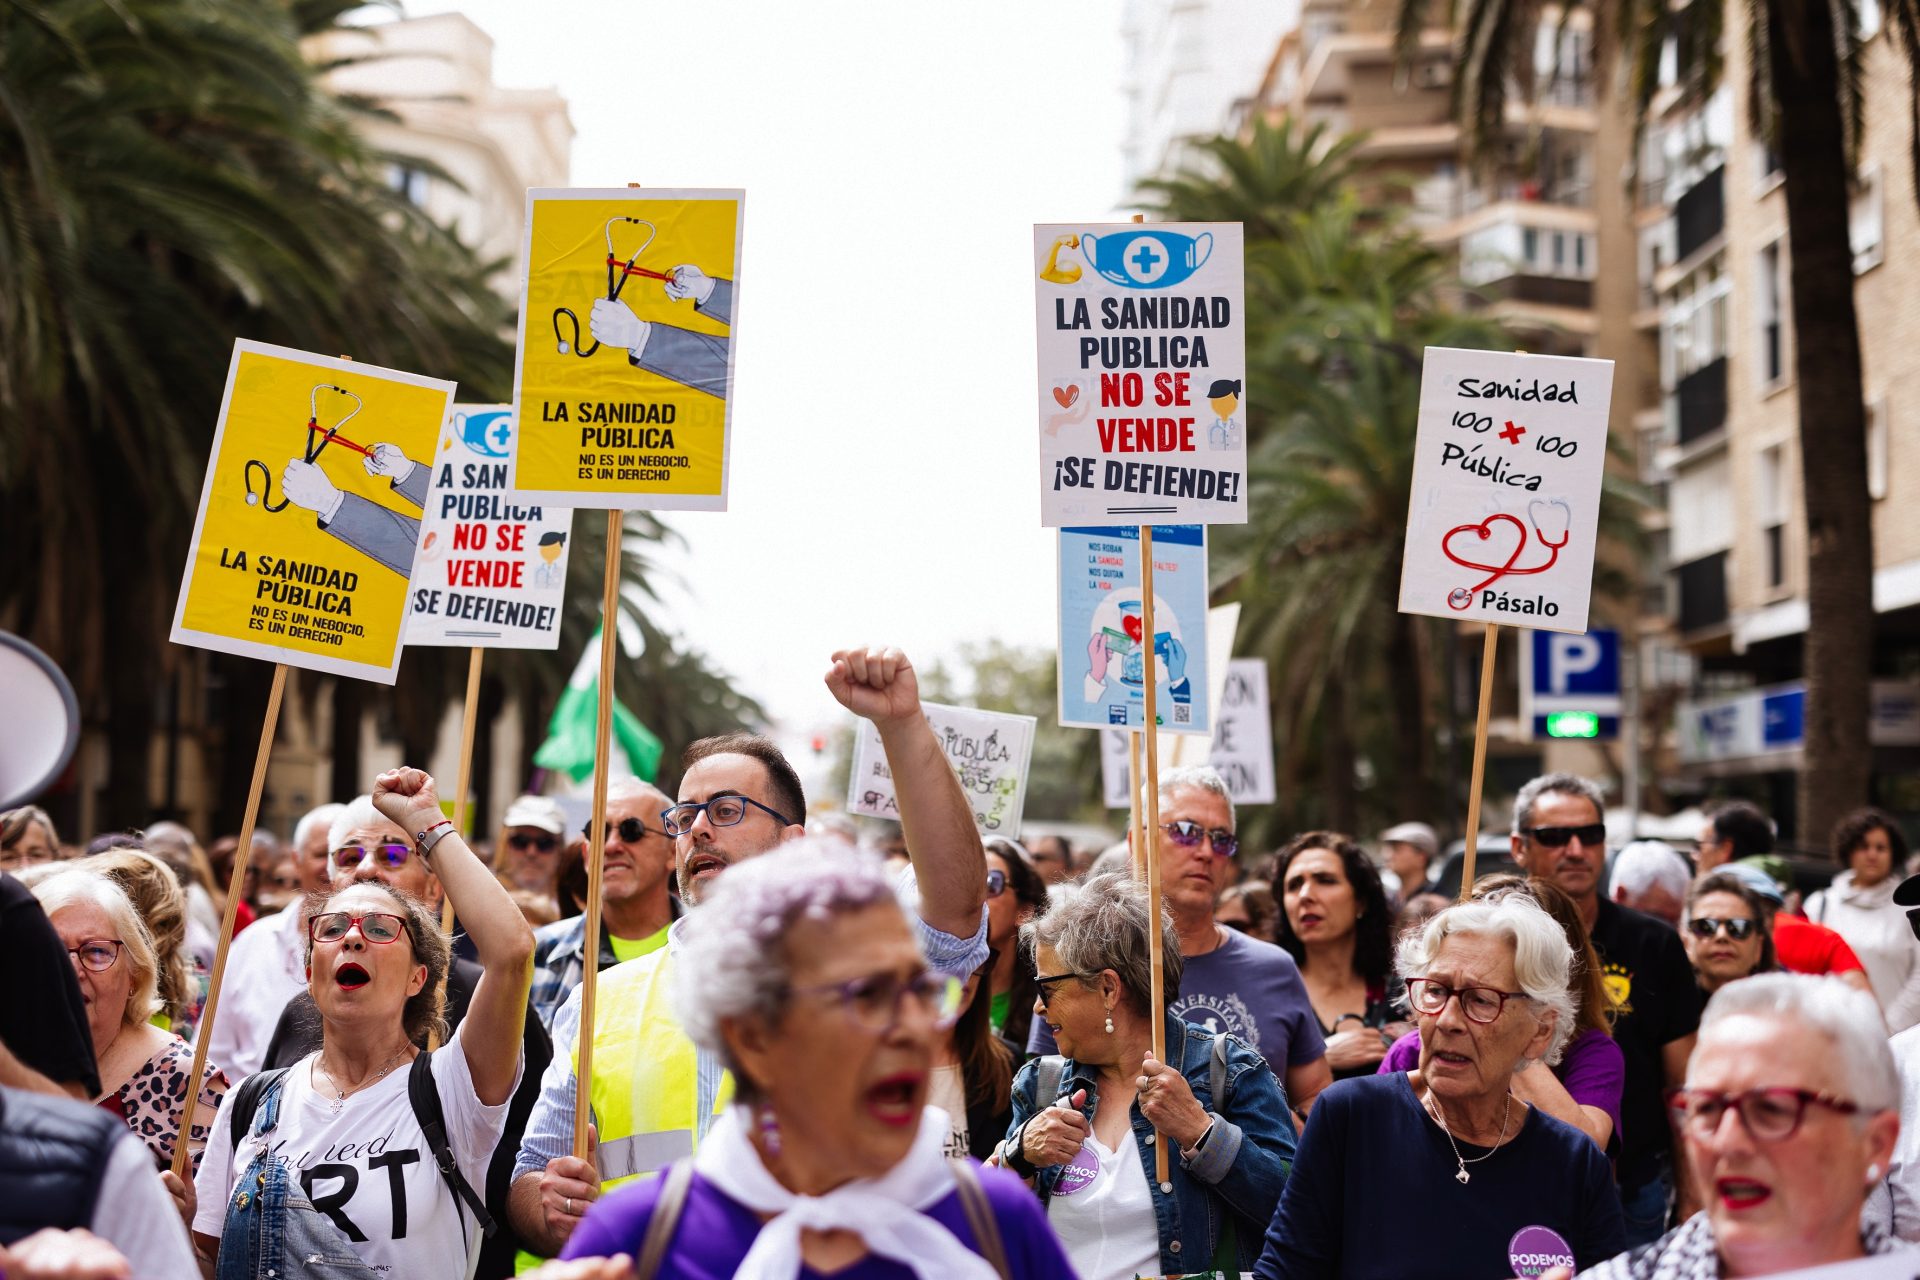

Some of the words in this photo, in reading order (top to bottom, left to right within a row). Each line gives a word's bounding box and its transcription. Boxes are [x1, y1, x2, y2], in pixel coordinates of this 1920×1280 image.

[1056, 298, 1091, 330] LA
[1101, 297, 1230, 329] SANIDAD
[1080, 336, 1208, 369] PUBLICA
[1101, 373, 1143, 407] NO
[1155, 372, 1190, 406] SE
[1458, 379, 1578, 404] Sanidad
[543, 402, 568, 422] LA
[578, 403, 676, 425] SANIDAD
[582, 424, 674, 449] PÚBLICA
[1097, 418, 1195, 452] VENDE
[1452, 411, 1492, 433] 100
[1536, 436, 1577, 458] 100
[437, 463, 453, 488] A
[579, 468, 592, 479] ES
[597, 469, 613, 479] UN
[618, 469, 670, 480] DERECHO
[580, 454, 595, 465] NO
[600, 455, 613, 465] ES
[619, 455, 634, 466] UN
[638, 455, 691, 470] NEGOCIO,
[1441, 442, 1543, 492] Pública
[1054, 457, 1096, 490] ¡SE
[1104, 460, 1240, 502] DEFIENDE!
[454, 524, 487, 550] NO
[496, 525, 525, 551] SE
[1088, 543, 1100, 551] NOS
[1102, 544, 1123, 554] ROBAN
[220, 548, 246, 571] LA
[256, 555, 358, 592] SANIDAD
[448, 560, 524, 588] VENDE
[1088, 556, 1096, 564] LA
[1088, 569, 1100, 577] NOS
[1102, 569, 1124, 579] QUITAN
[256, 579, 352, 616] PÚBLICA
[1088, 581, 1096, 589] LA
[445, 592, 557, 632] DEFIENDE!
[1482, 591, 1558, 616] Pásalo
[249, 618, 264, 630] ES
[268, 621, 286, 634] UN
[289, 626, 343, 646] DERECHO
[251, 604, 269, 618] NO
[272, 609, 288, 621] ES
[292, 612, 309, 625] UN
[312, 616, 365, 638] NEGOCIO,
[1549, 632, 1601, 695] P
[1169, 993, 1243, 1032] IVERSITAS
[1062, 1174, 1080, 1183] AGA
[1063, 1164, 1097, 1179] EMOS
[300, 1148, 420, 1243] RT
[1510, 1253, 1575, 1268] PODEMOS
